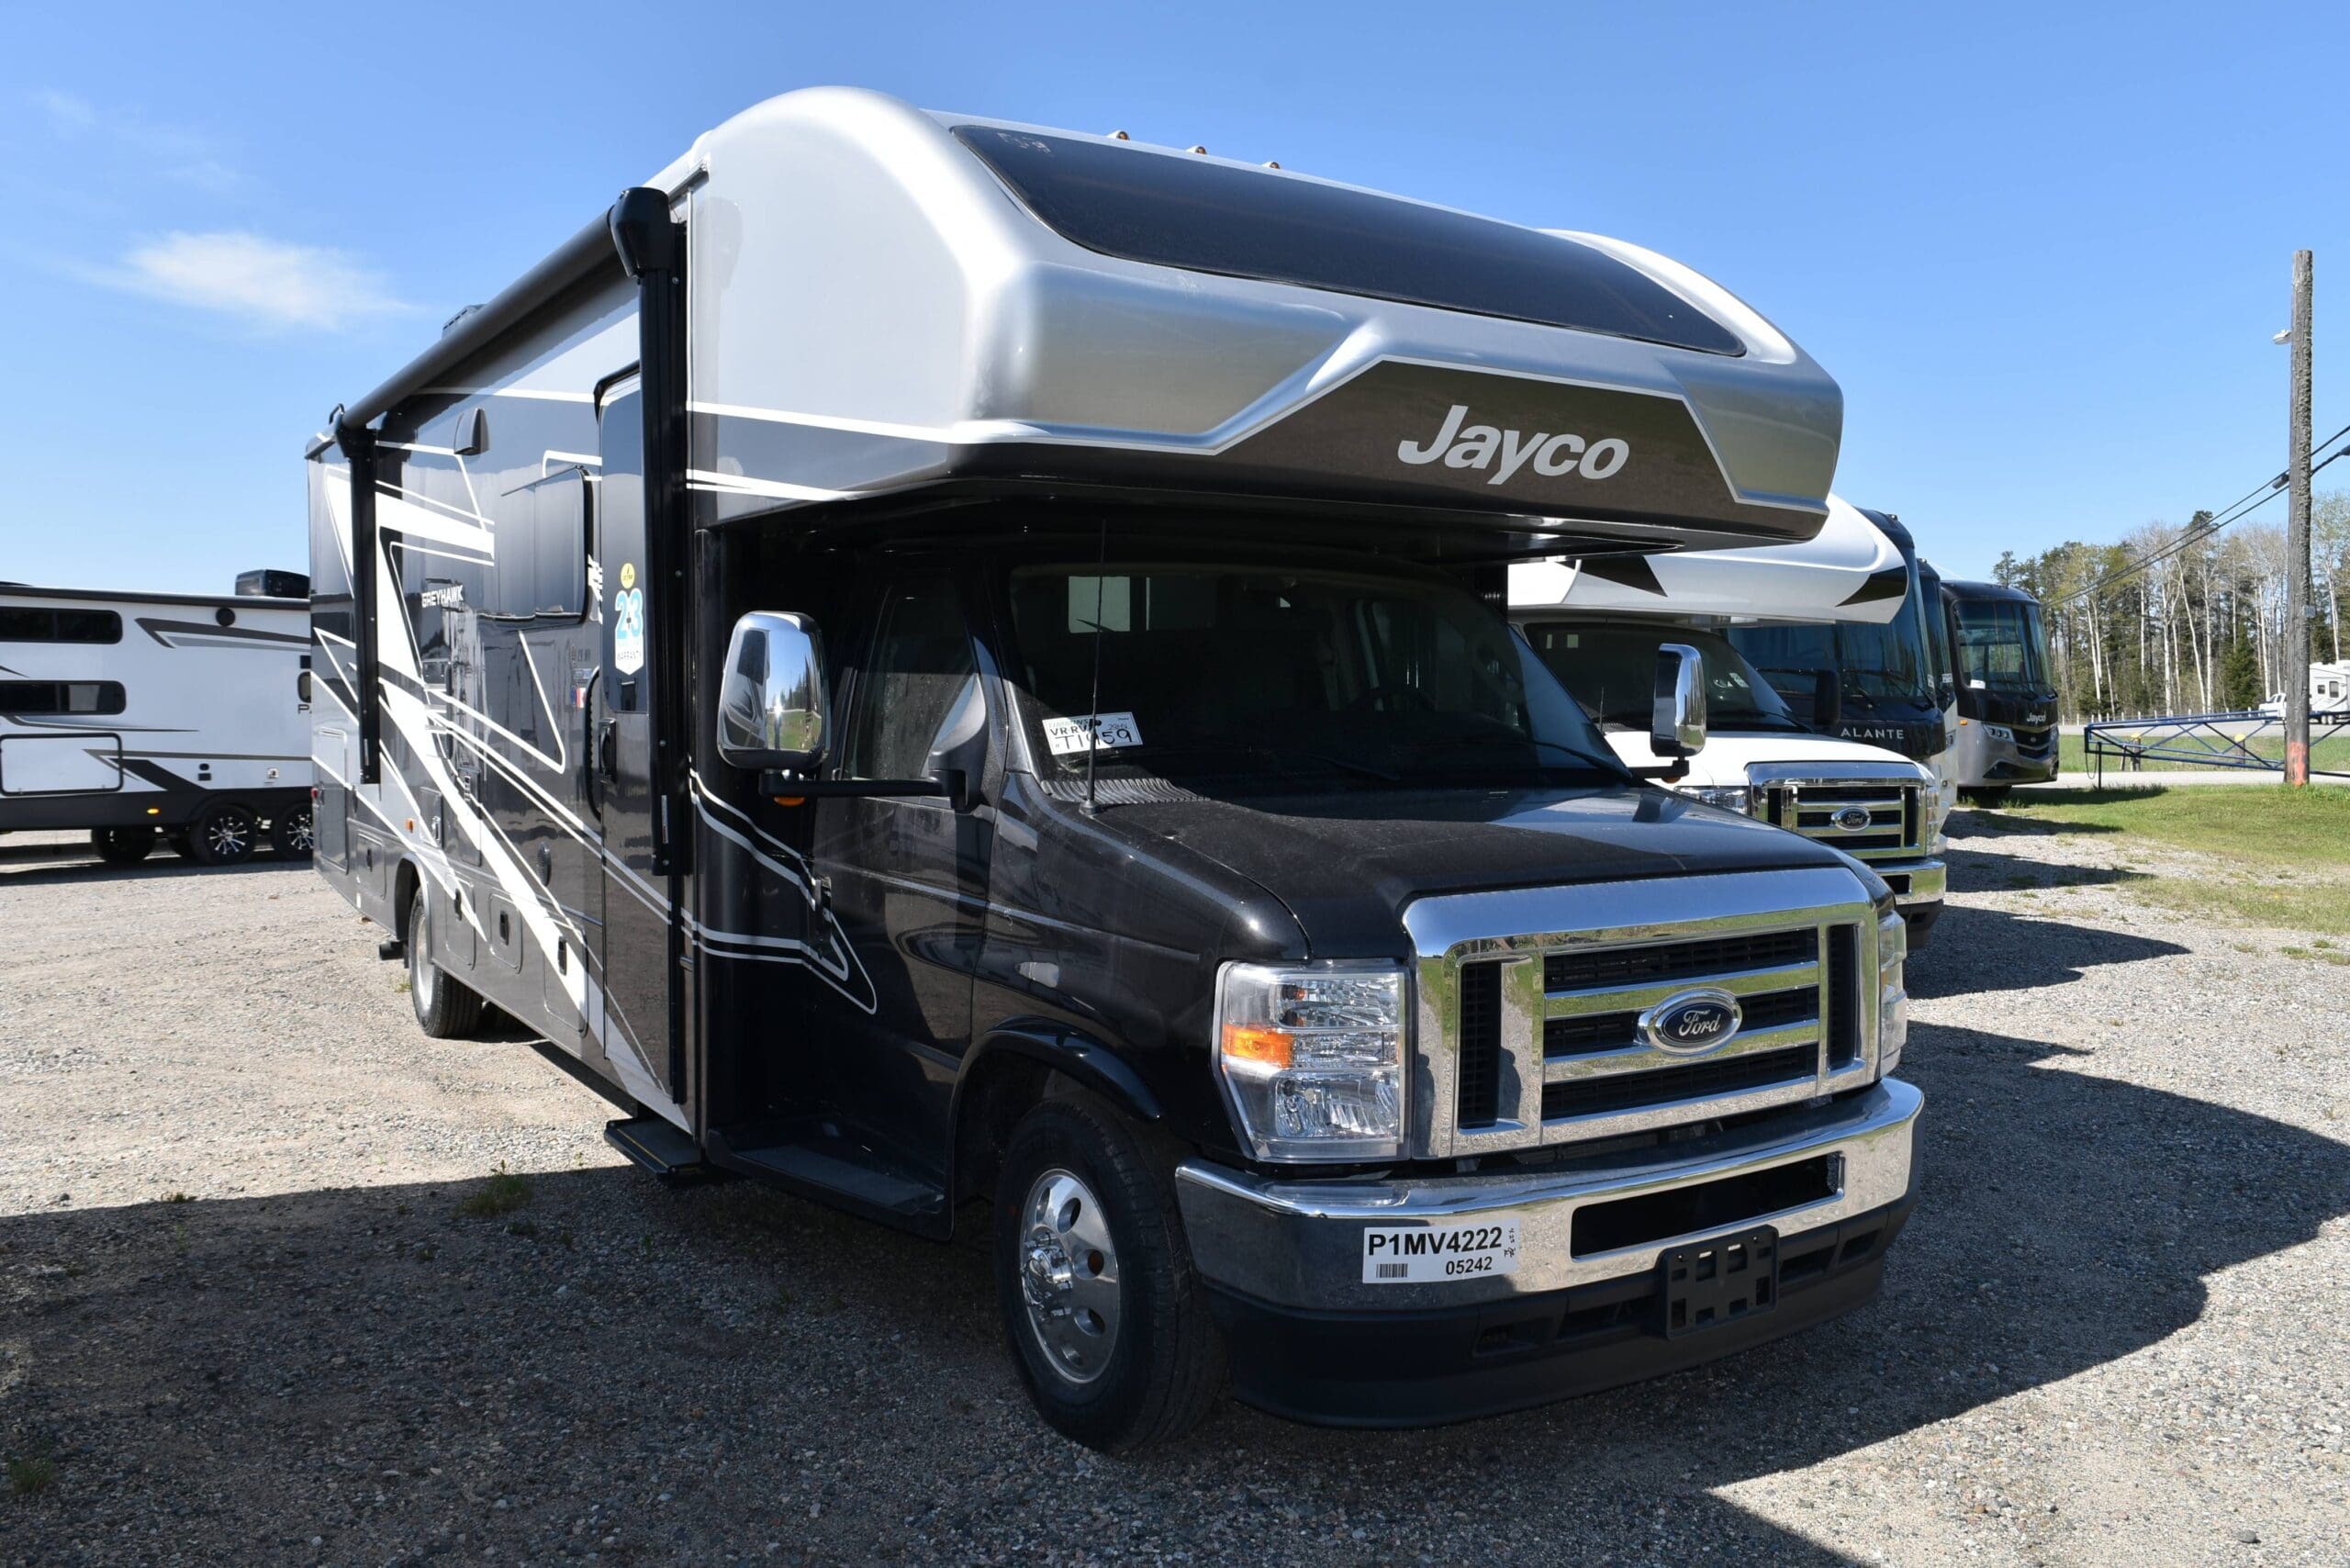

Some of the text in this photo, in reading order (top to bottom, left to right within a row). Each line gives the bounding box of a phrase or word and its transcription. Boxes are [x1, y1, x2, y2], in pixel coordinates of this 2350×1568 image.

[1397, 404, 1629, 486] Jayco
[421, 585, 464, 608] GREYHAWK
[2026, 711, 2047, 725] Jayco
[1840, 726, 1905, 740] ALANTE
[1678, 1009, 1722, 1036] Ford
[1368, 1226, 1503, 1256] P1MV4222
[1445, 1256, 1493, 1275] 05242
